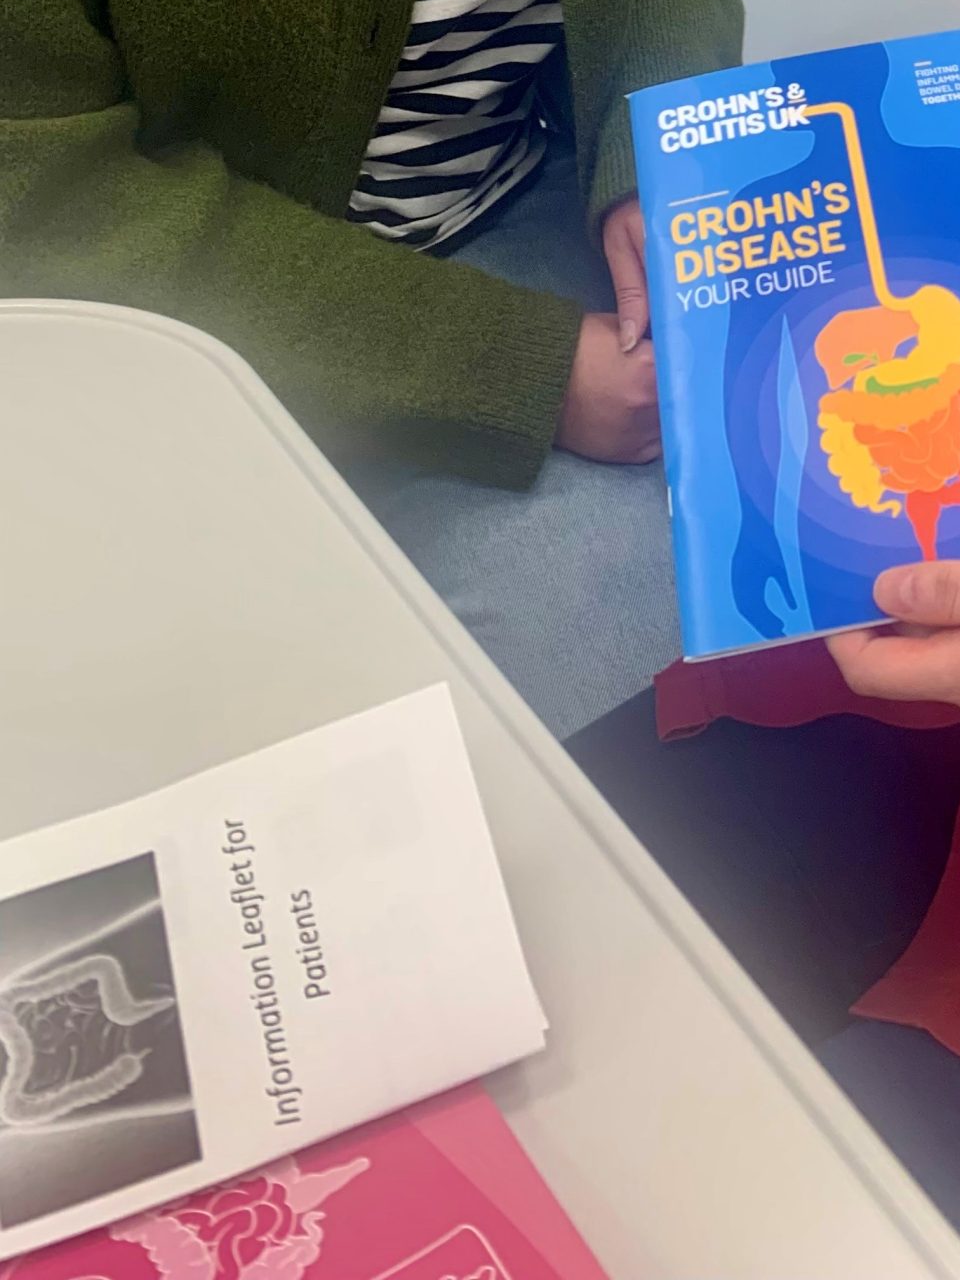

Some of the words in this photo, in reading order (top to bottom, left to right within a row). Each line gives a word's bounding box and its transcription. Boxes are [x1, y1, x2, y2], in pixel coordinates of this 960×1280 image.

[914, 64, 960, 78] FIGHTING
[919, 84, 953, 96] BOWEL
[657, 86, 785, 131] CROHN'S
[786, 82, 806, 104] &
[660, 113, 766, 154] COLITIS
[768, 104, 810, 130] UK
[670, 181, 851, 246] CROHN'S
[674, 220, 846, 284] DISEASE
[676, 277, 752, 312] YOUR
[755, 260, 836, 296] GUIDE
[221, 819, 255, 854] for
[229, 860, 267, 950] Leaflet
[290, 889, 331, 1000] Patients
[249, 955, 303, 1126] Information
